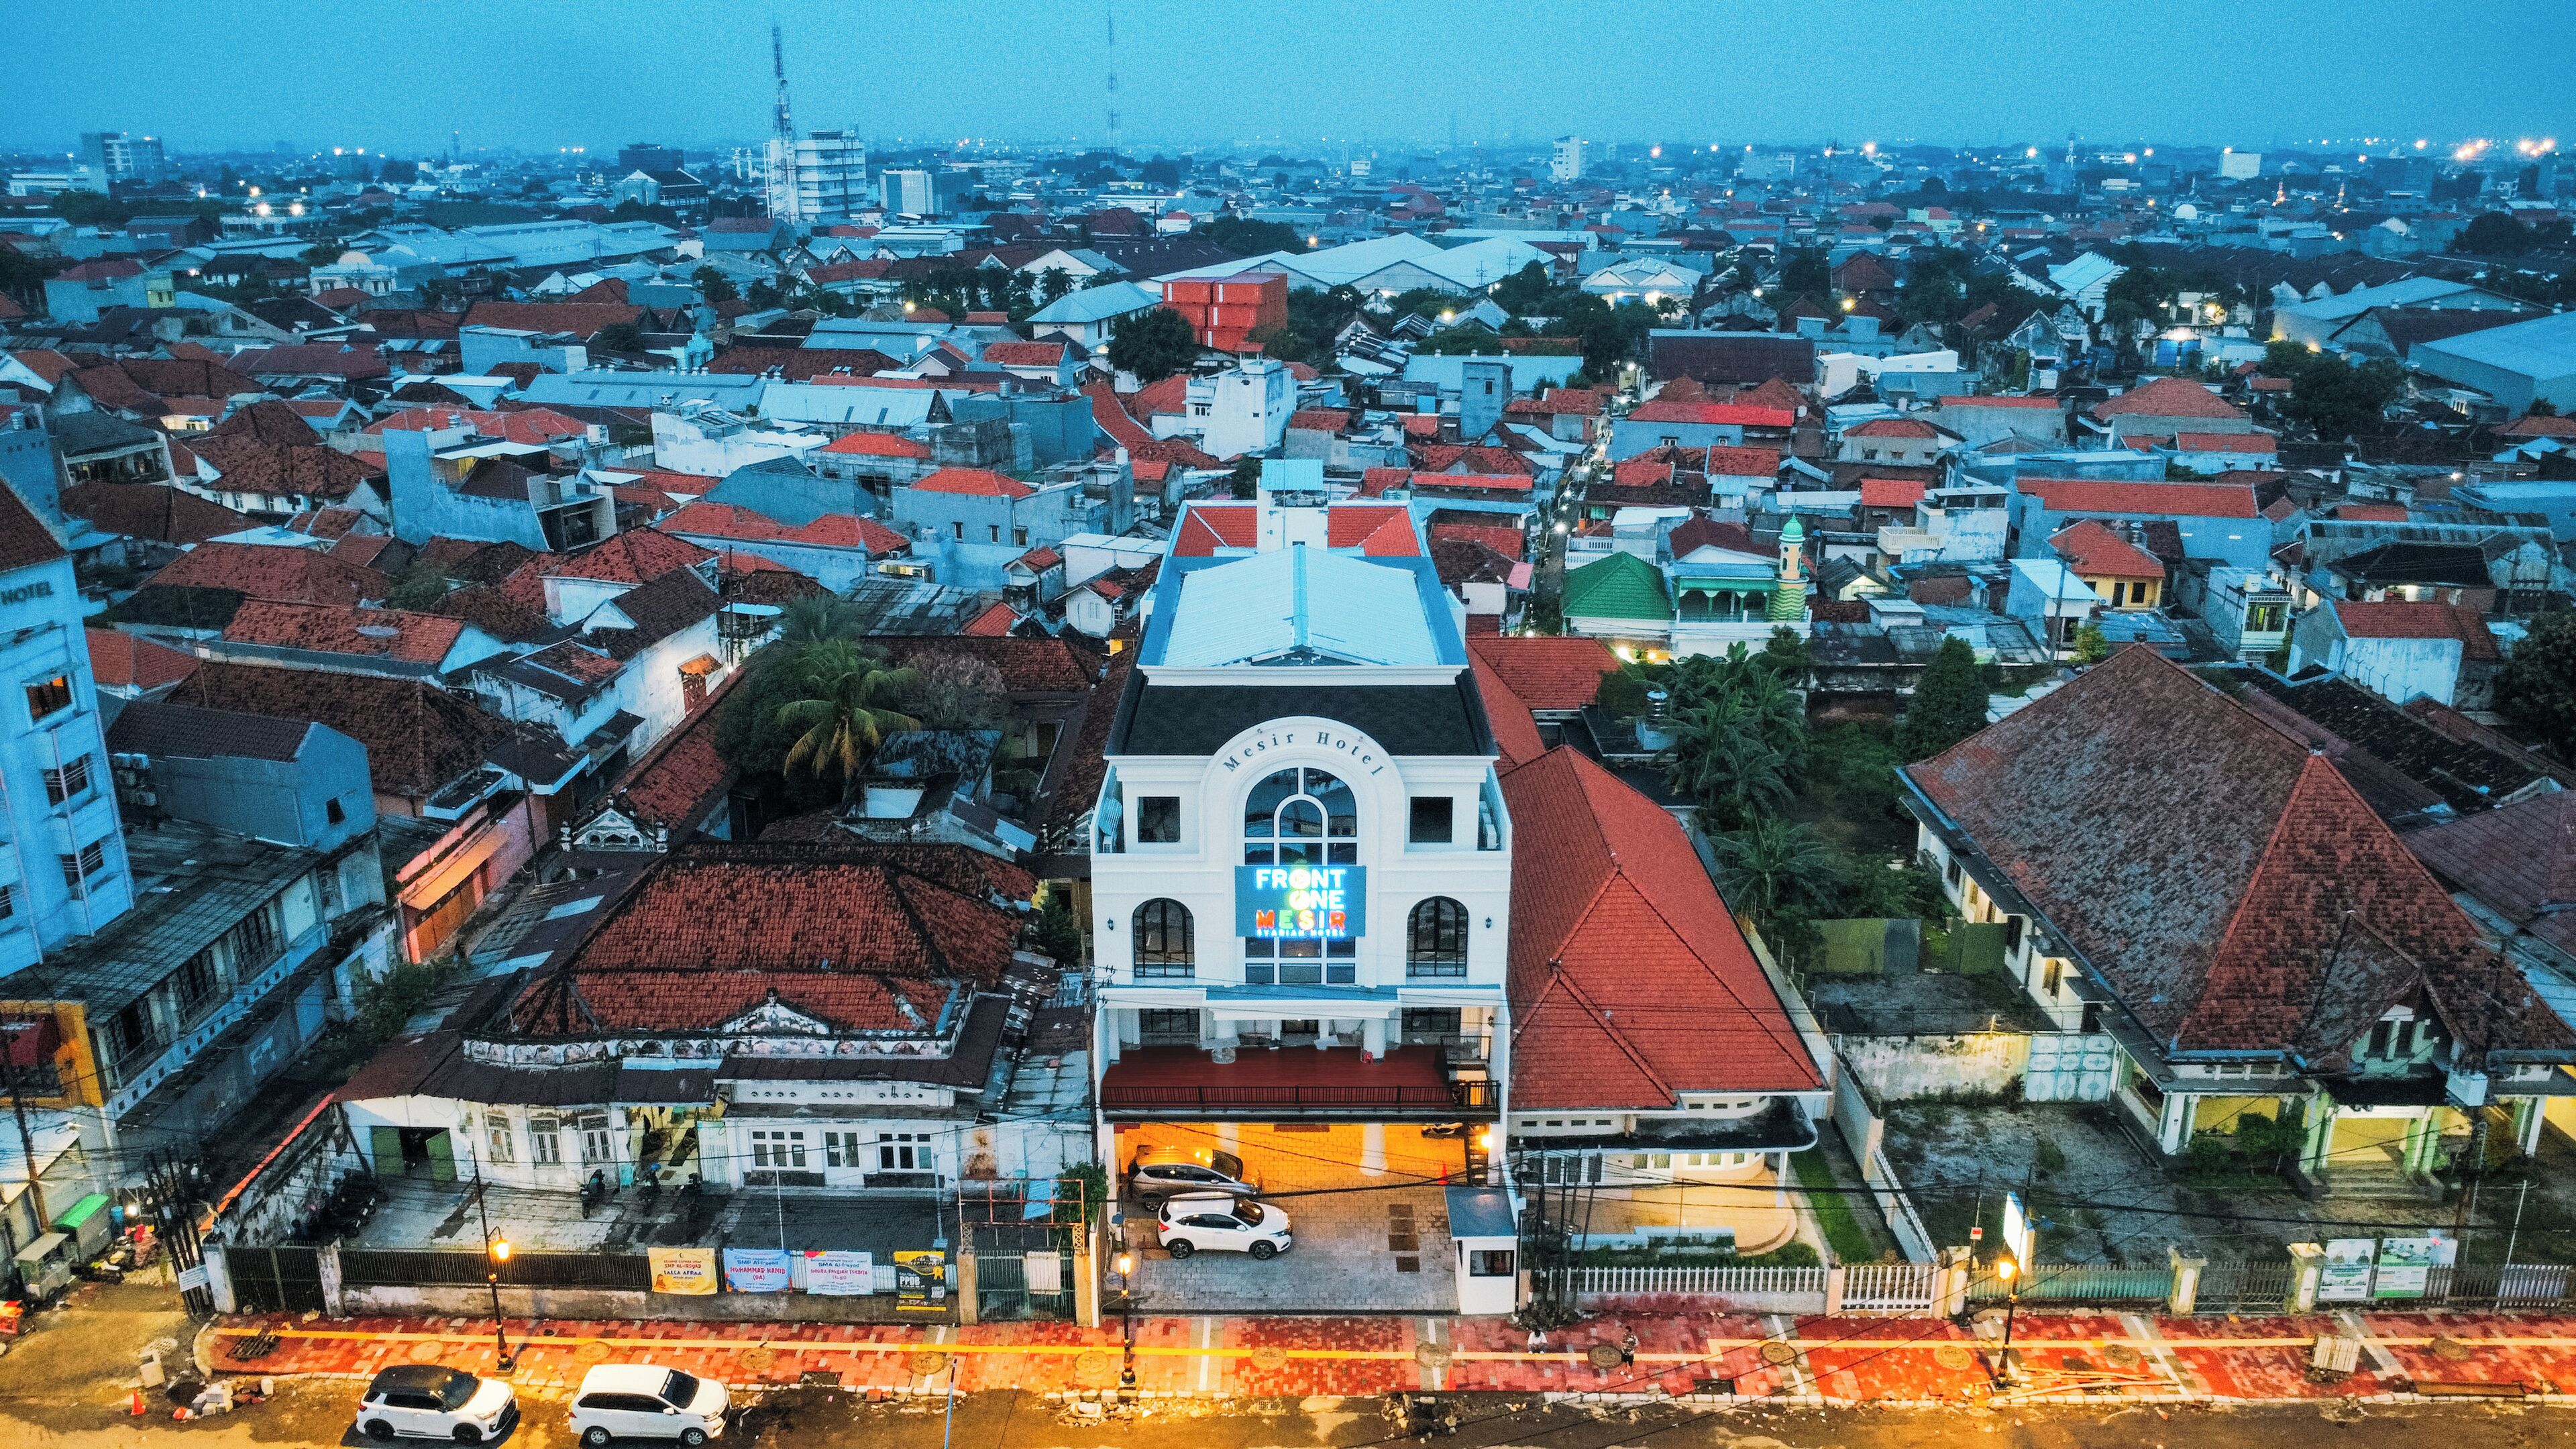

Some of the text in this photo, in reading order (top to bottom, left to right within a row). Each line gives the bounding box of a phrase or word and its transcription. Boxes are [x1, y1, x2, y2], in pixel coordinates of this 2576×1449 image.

[1, 582, 54, 605] HOTEL
[1223, 731, 1384, 775] Mesir Hotel
[1256, 869, 1346, 890] FRONT
[1289, 890, 1344, 910] ONE
[1256, 910, 1346, 930] MESIR
[900, 1277, 920, 1285] PPDB
